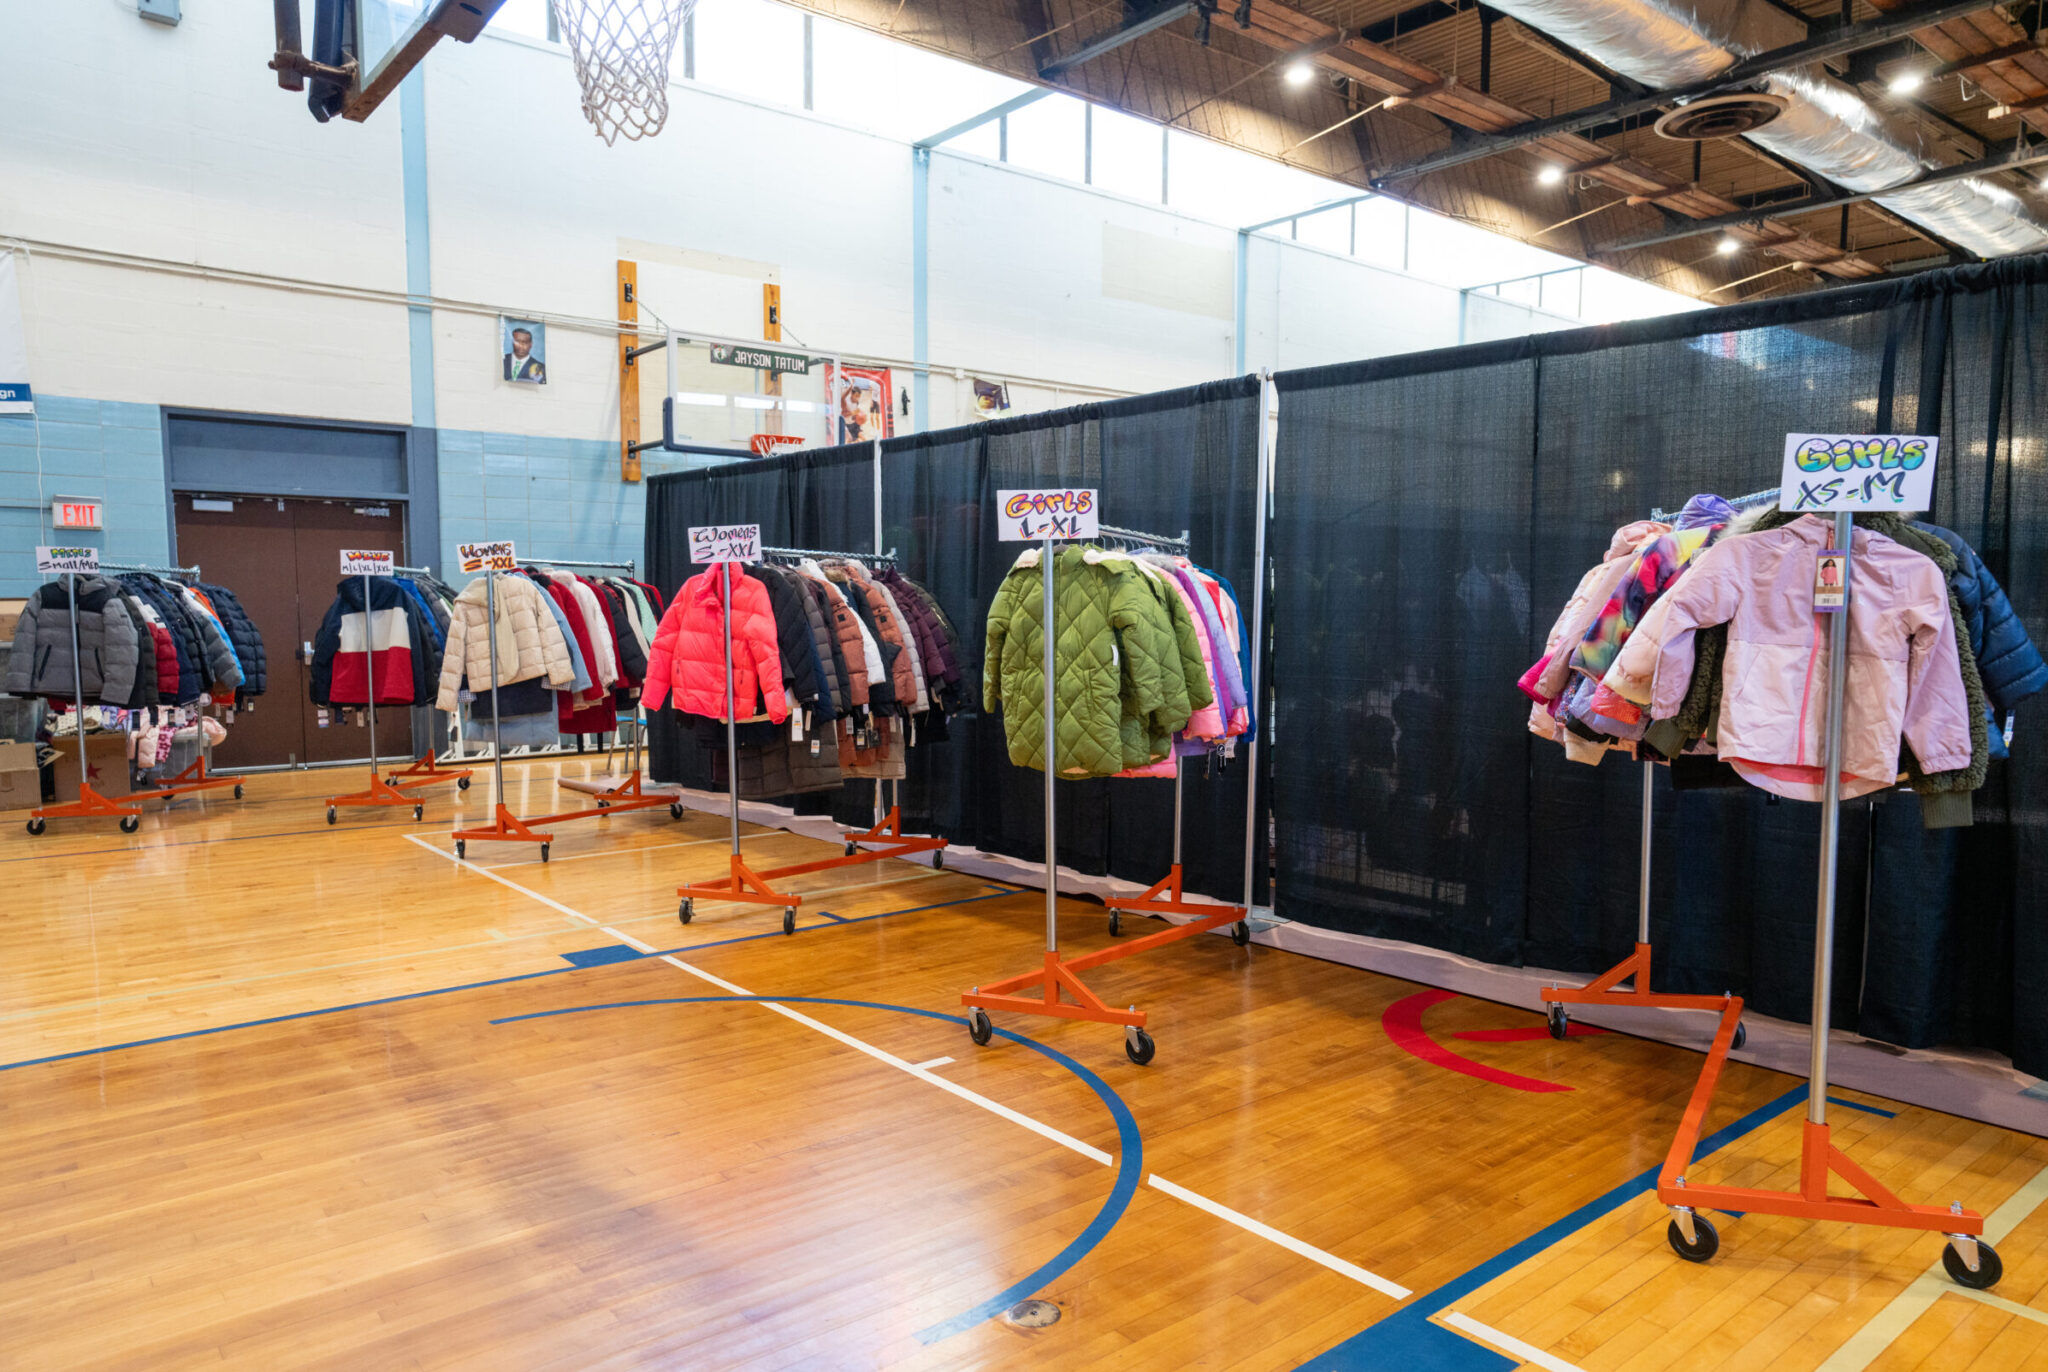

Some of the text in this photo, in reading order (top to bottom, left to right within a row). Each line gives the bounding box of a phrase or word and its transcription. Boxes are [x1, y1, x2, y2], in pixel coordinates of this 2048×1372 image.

[734, 350, 805, 371] JAYSON TATUM
[62, 504, 95, 526] EXIT
